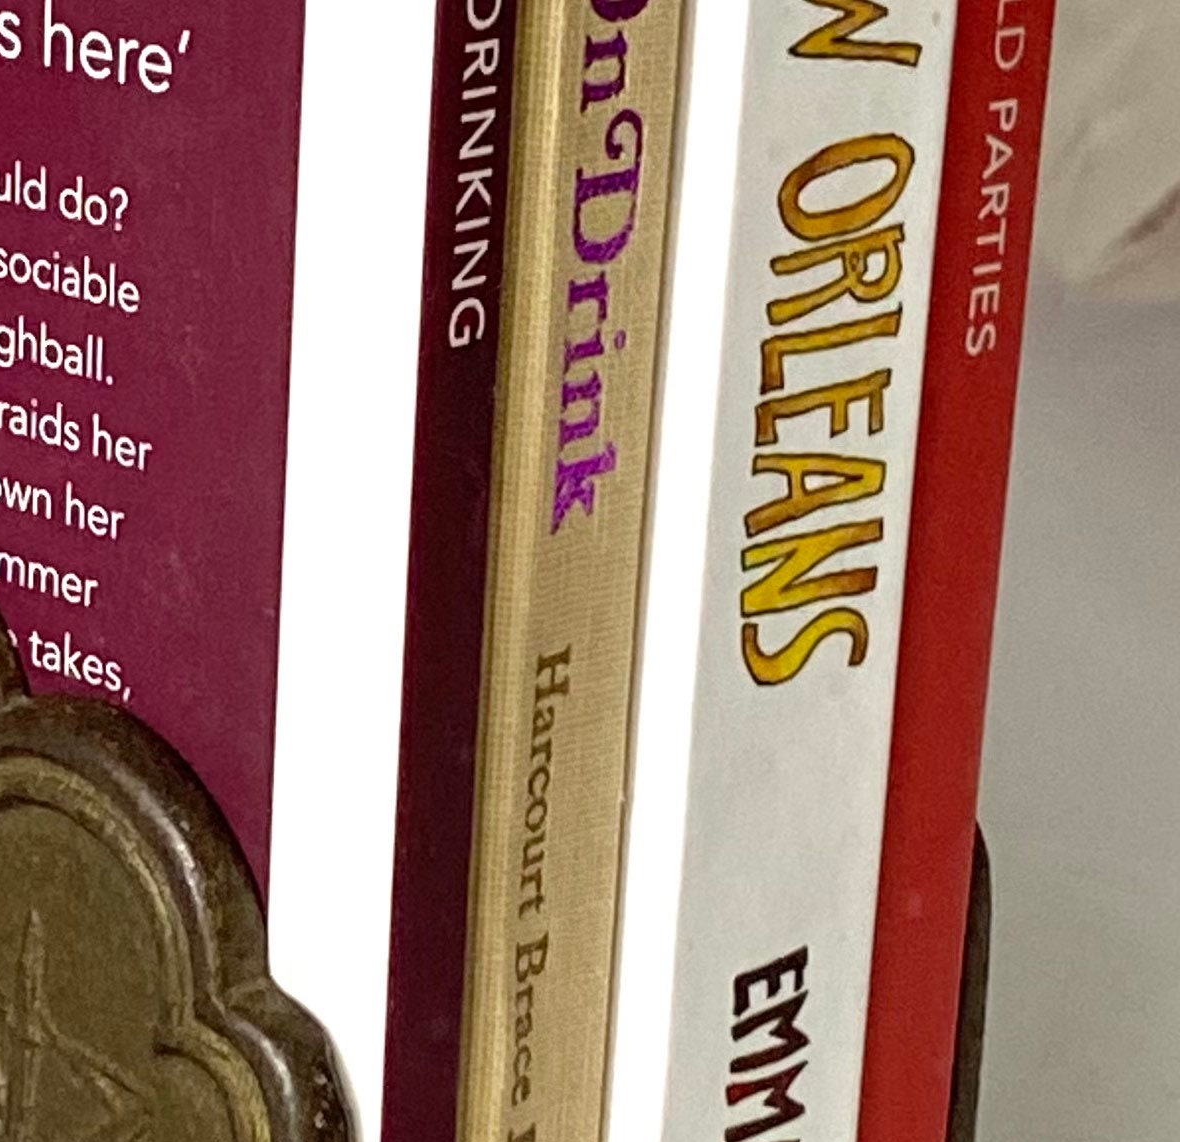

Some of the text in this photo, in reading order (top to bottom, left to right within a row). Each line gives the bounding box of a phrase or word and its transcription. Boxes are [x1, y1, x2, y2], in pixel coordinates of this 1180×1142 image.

[59, 176, 129, 232] do?
[965, 97, 1019, 357] PARTIES
[550, 108, 643, 535] Drink
[740, 133, 916, 686] ORLEANS
[65, 481, 125, 540] her
[92, 413, 153, 471] her
[29, 630, 131, 702] takes,
[518, 643, 572, 919] Harcourt
[511, 931, 549, 1107] Brace
